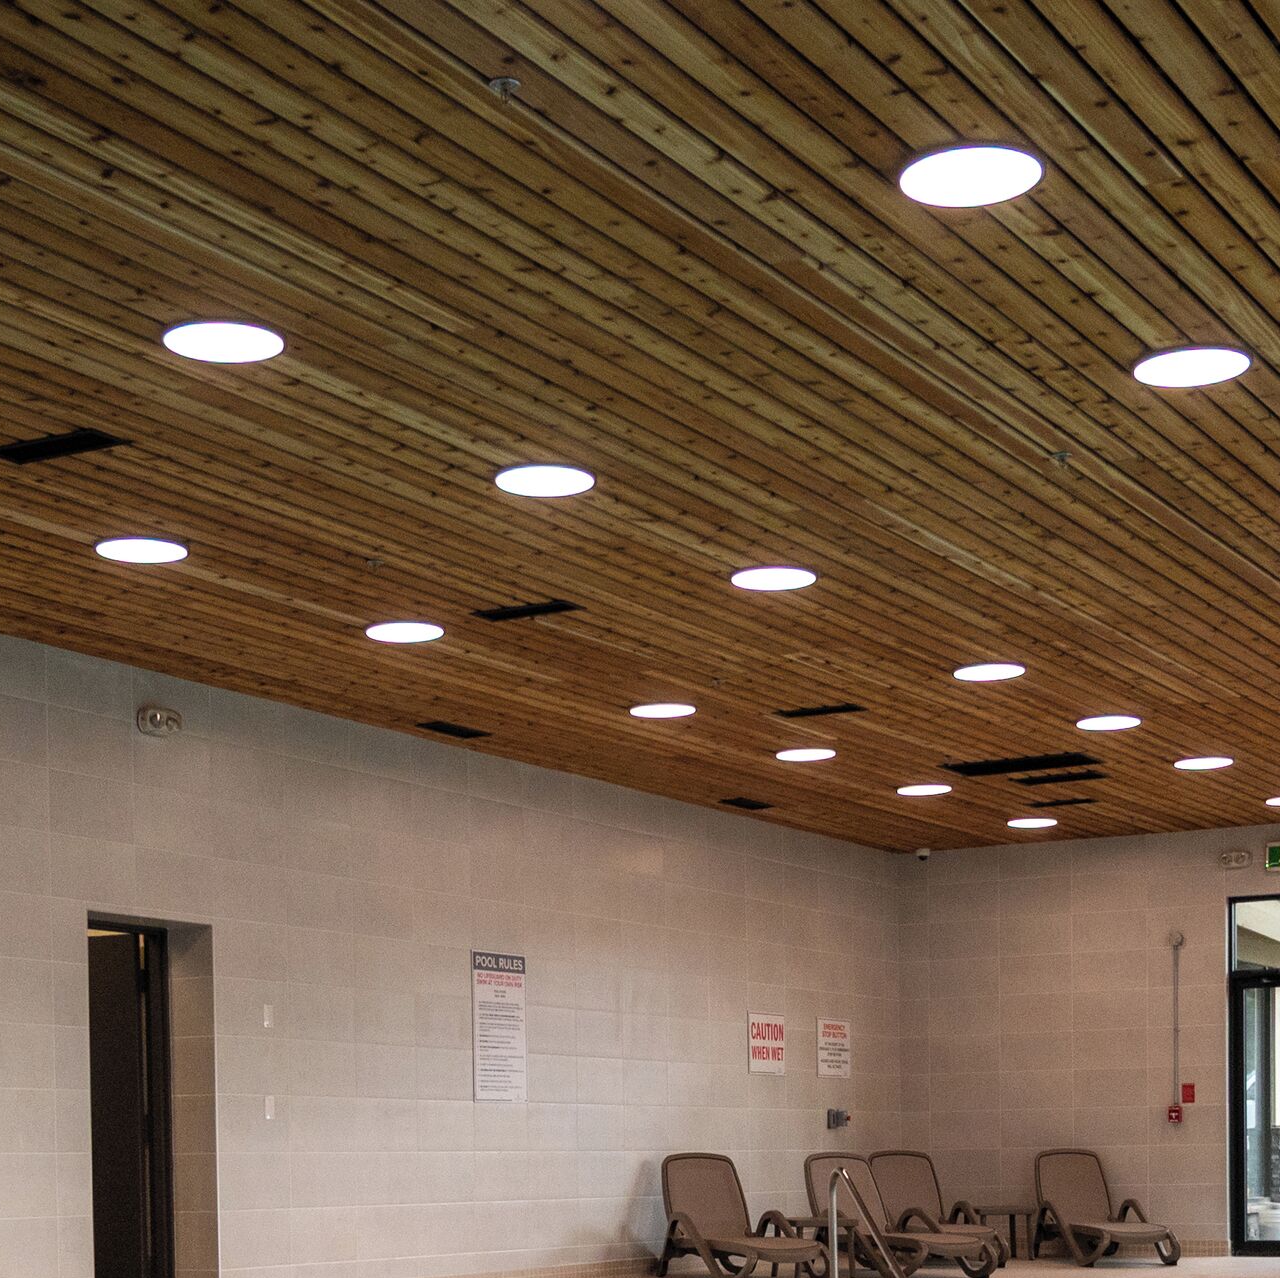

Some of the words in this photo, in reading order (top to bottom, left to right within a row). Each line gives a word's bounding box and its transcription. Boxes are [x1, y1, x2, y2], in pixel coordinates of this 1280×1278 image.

[475, 956, 497, 968] POOL
[499, 958, 523, 971] RULES
[751, 1022, 784, 1041] CAUTION
[752, 1046, 770, 1060] WHEN
[771, 1046, 784, 1061] WET
